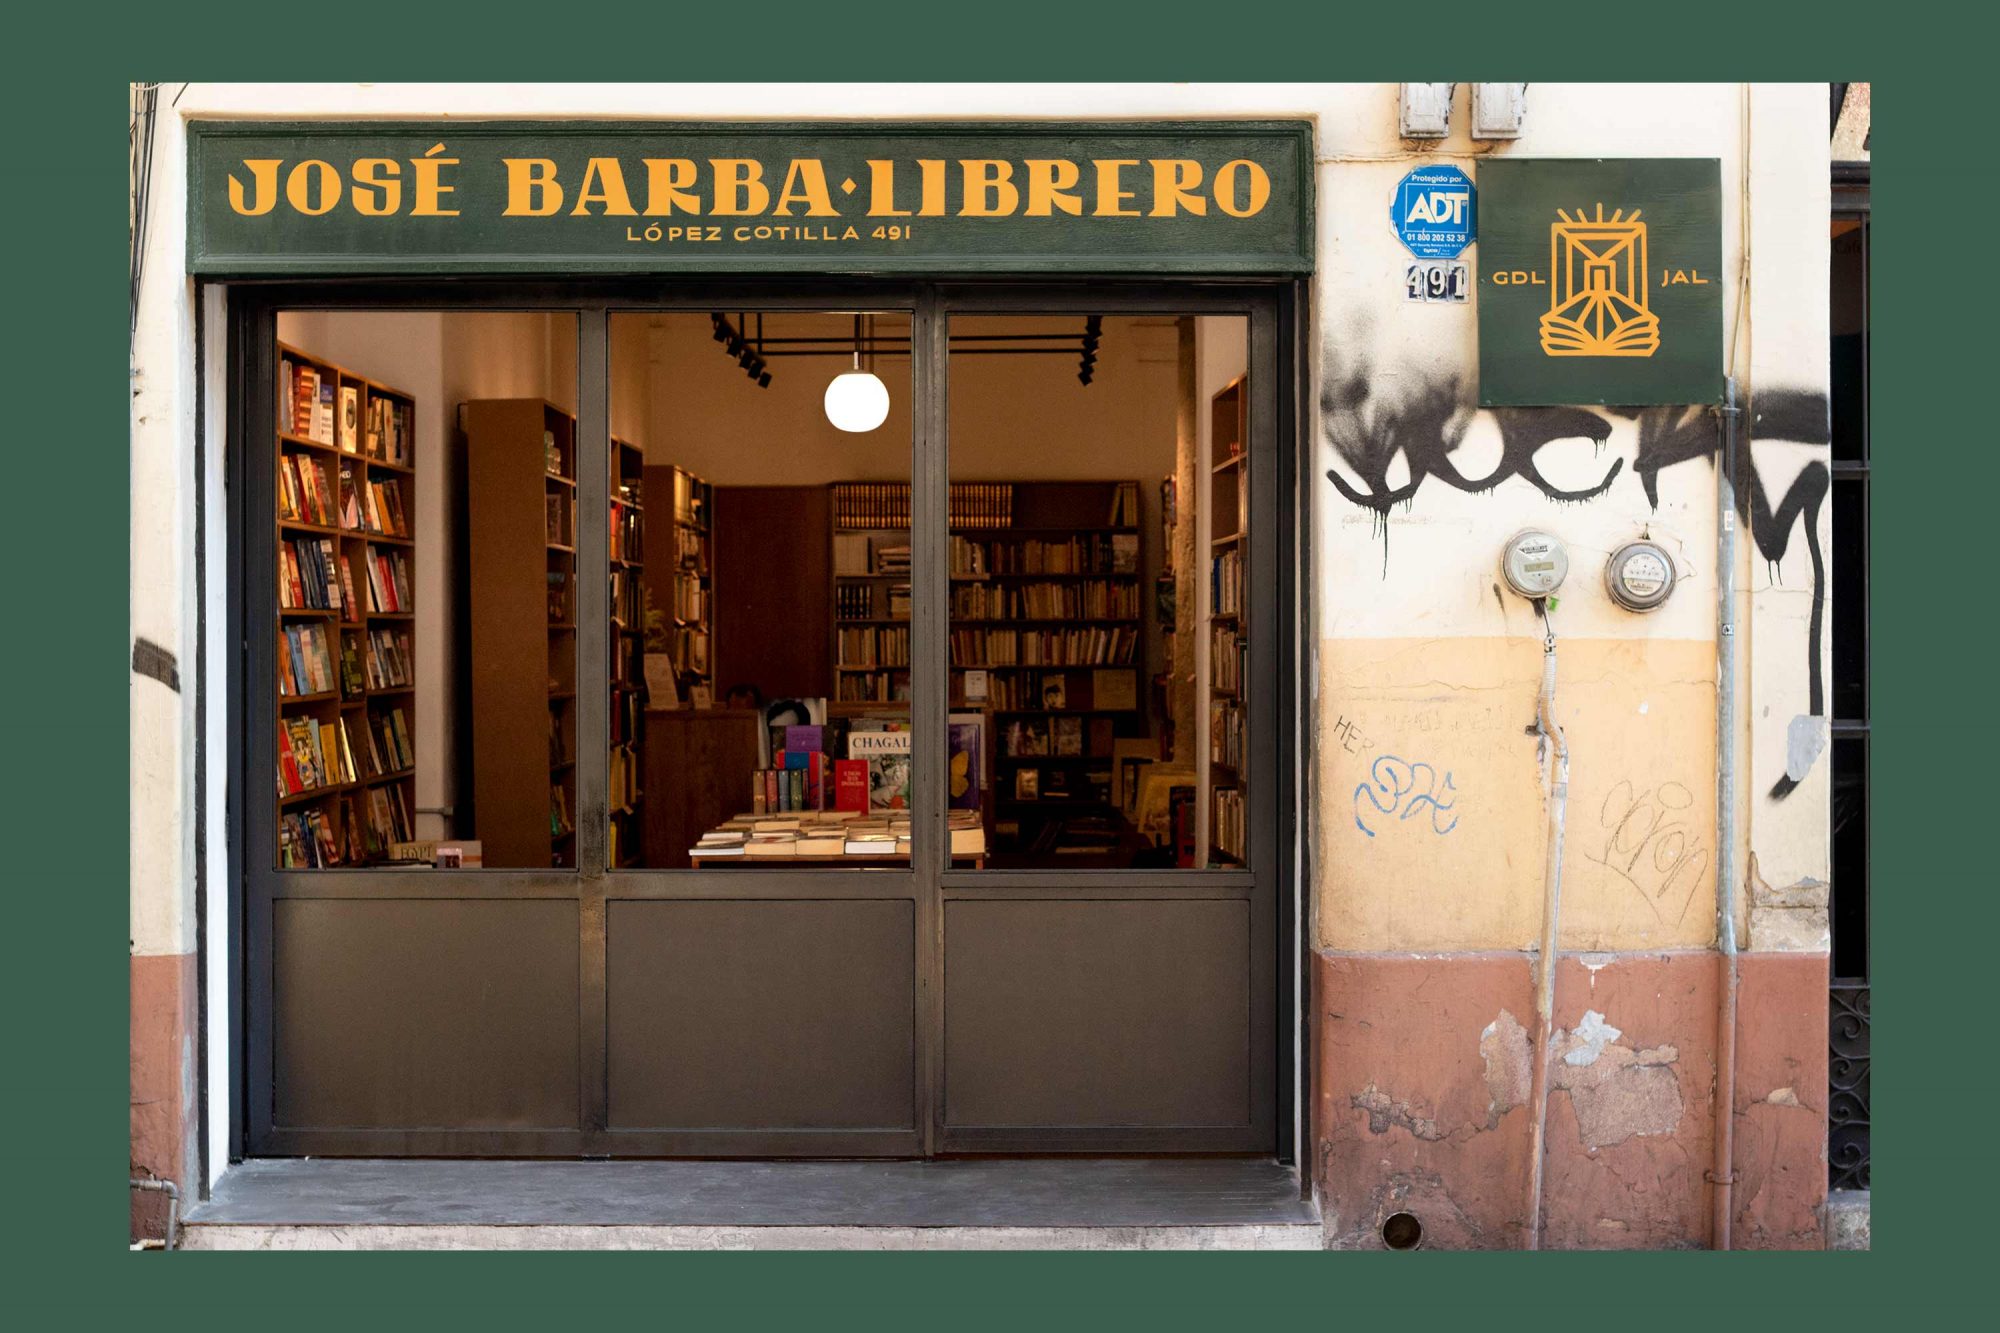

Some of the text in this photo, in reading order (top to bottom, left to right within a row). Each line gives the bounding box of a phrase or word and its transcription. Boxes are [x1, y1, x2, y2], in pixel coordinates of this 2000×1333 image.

[228, 142, 461, 216] JOSÉ
[1412, 175, 1448, 183] Protegido
[1406, 192, 1469, 224] ADT
[627, 223, 911, 242] LÓPEZ COTILLA 491
[1406, 233, 1416, 241] 01
[1417, 233, 1431, 241] 800
[1431, 233, 1445, 242] 202
[1446, 234, 1456, 242] 52
[1406, 264, 1465, 299] 491
[1492, 271, 1546, 285] GDL
[1661, 269, 1709, 288] JAL
